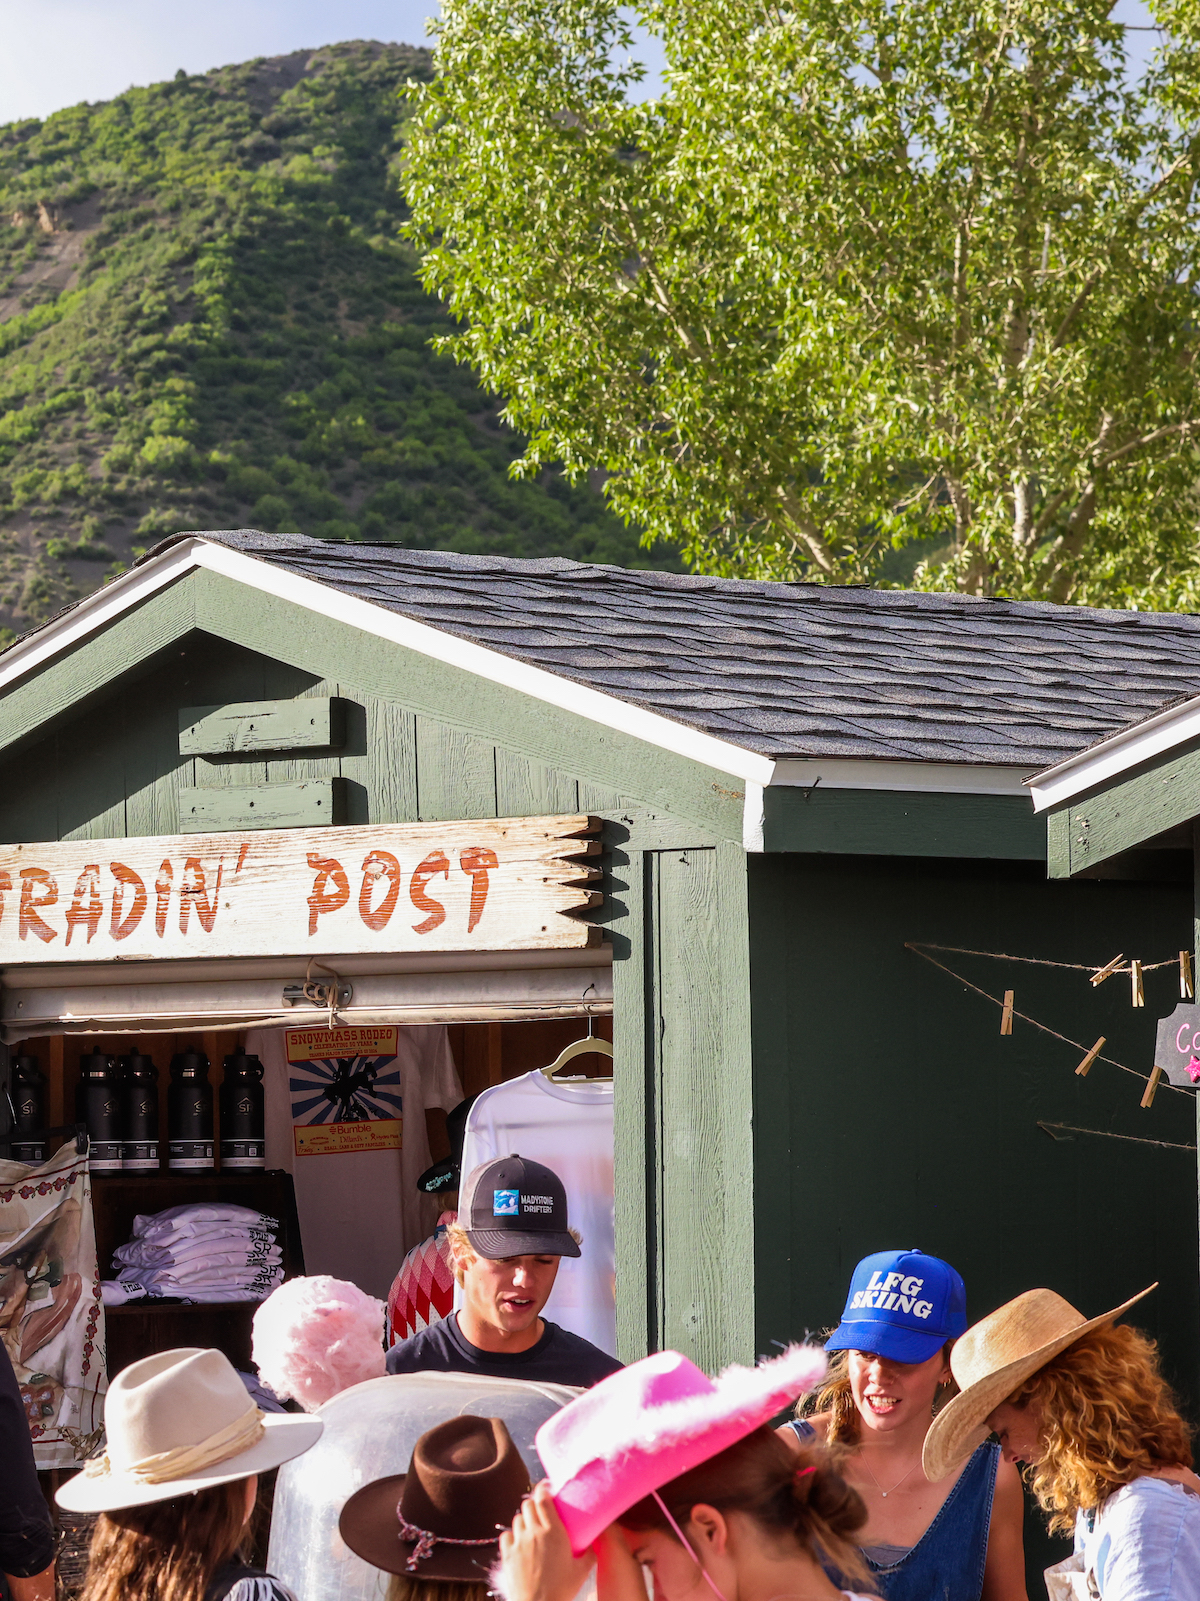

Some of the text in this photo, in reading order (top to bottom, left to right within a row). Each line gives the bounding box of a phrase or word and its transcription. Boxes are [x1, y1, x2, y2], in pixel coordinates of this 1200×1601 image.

[306, 846, 499, 937] POST
[290, 1029, 393, 1045] SNOWMASS RODEO
[313, 1042, 349, 1050] CELEBRATING
[337, 1124, 371, 1134] Bumble
[524, 1205, 552, 1213] DRIFTERS
[254, 1241, 272, 1254] SR
[260, 1264, 278, 1276] SR
[866, 1270, 924, 1297] LFG
[849, 1290, 933, 1319] SKIING
